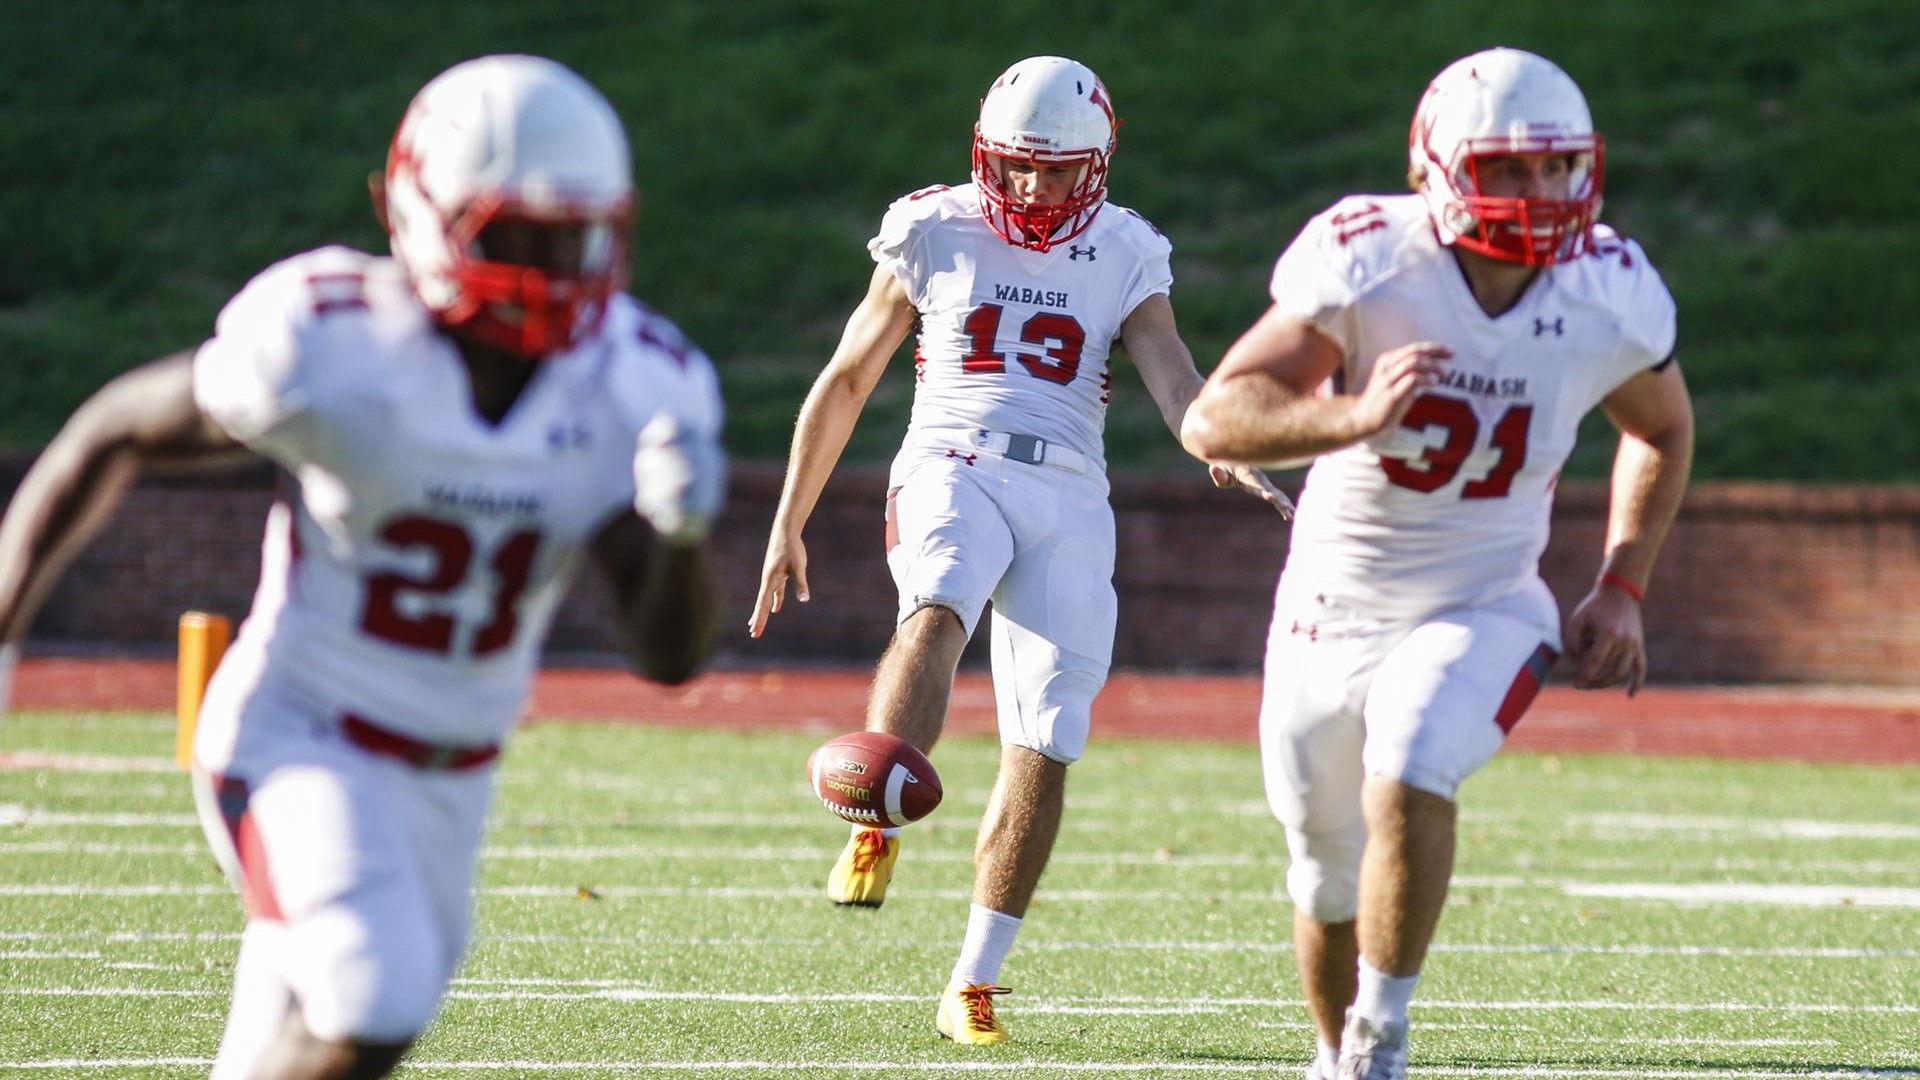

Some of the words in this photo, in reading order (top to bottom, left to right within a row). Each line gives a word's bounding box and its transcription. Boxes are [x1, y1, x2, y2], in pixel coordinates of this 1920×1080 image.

[995, 284, 1068, 308] WABASH
[962, 302, 1086, 386] 13
[1379, 391, 1534, 500] 31
[359, 512, 545, 660] 21
[827, 780, 870, 802] Wilson
